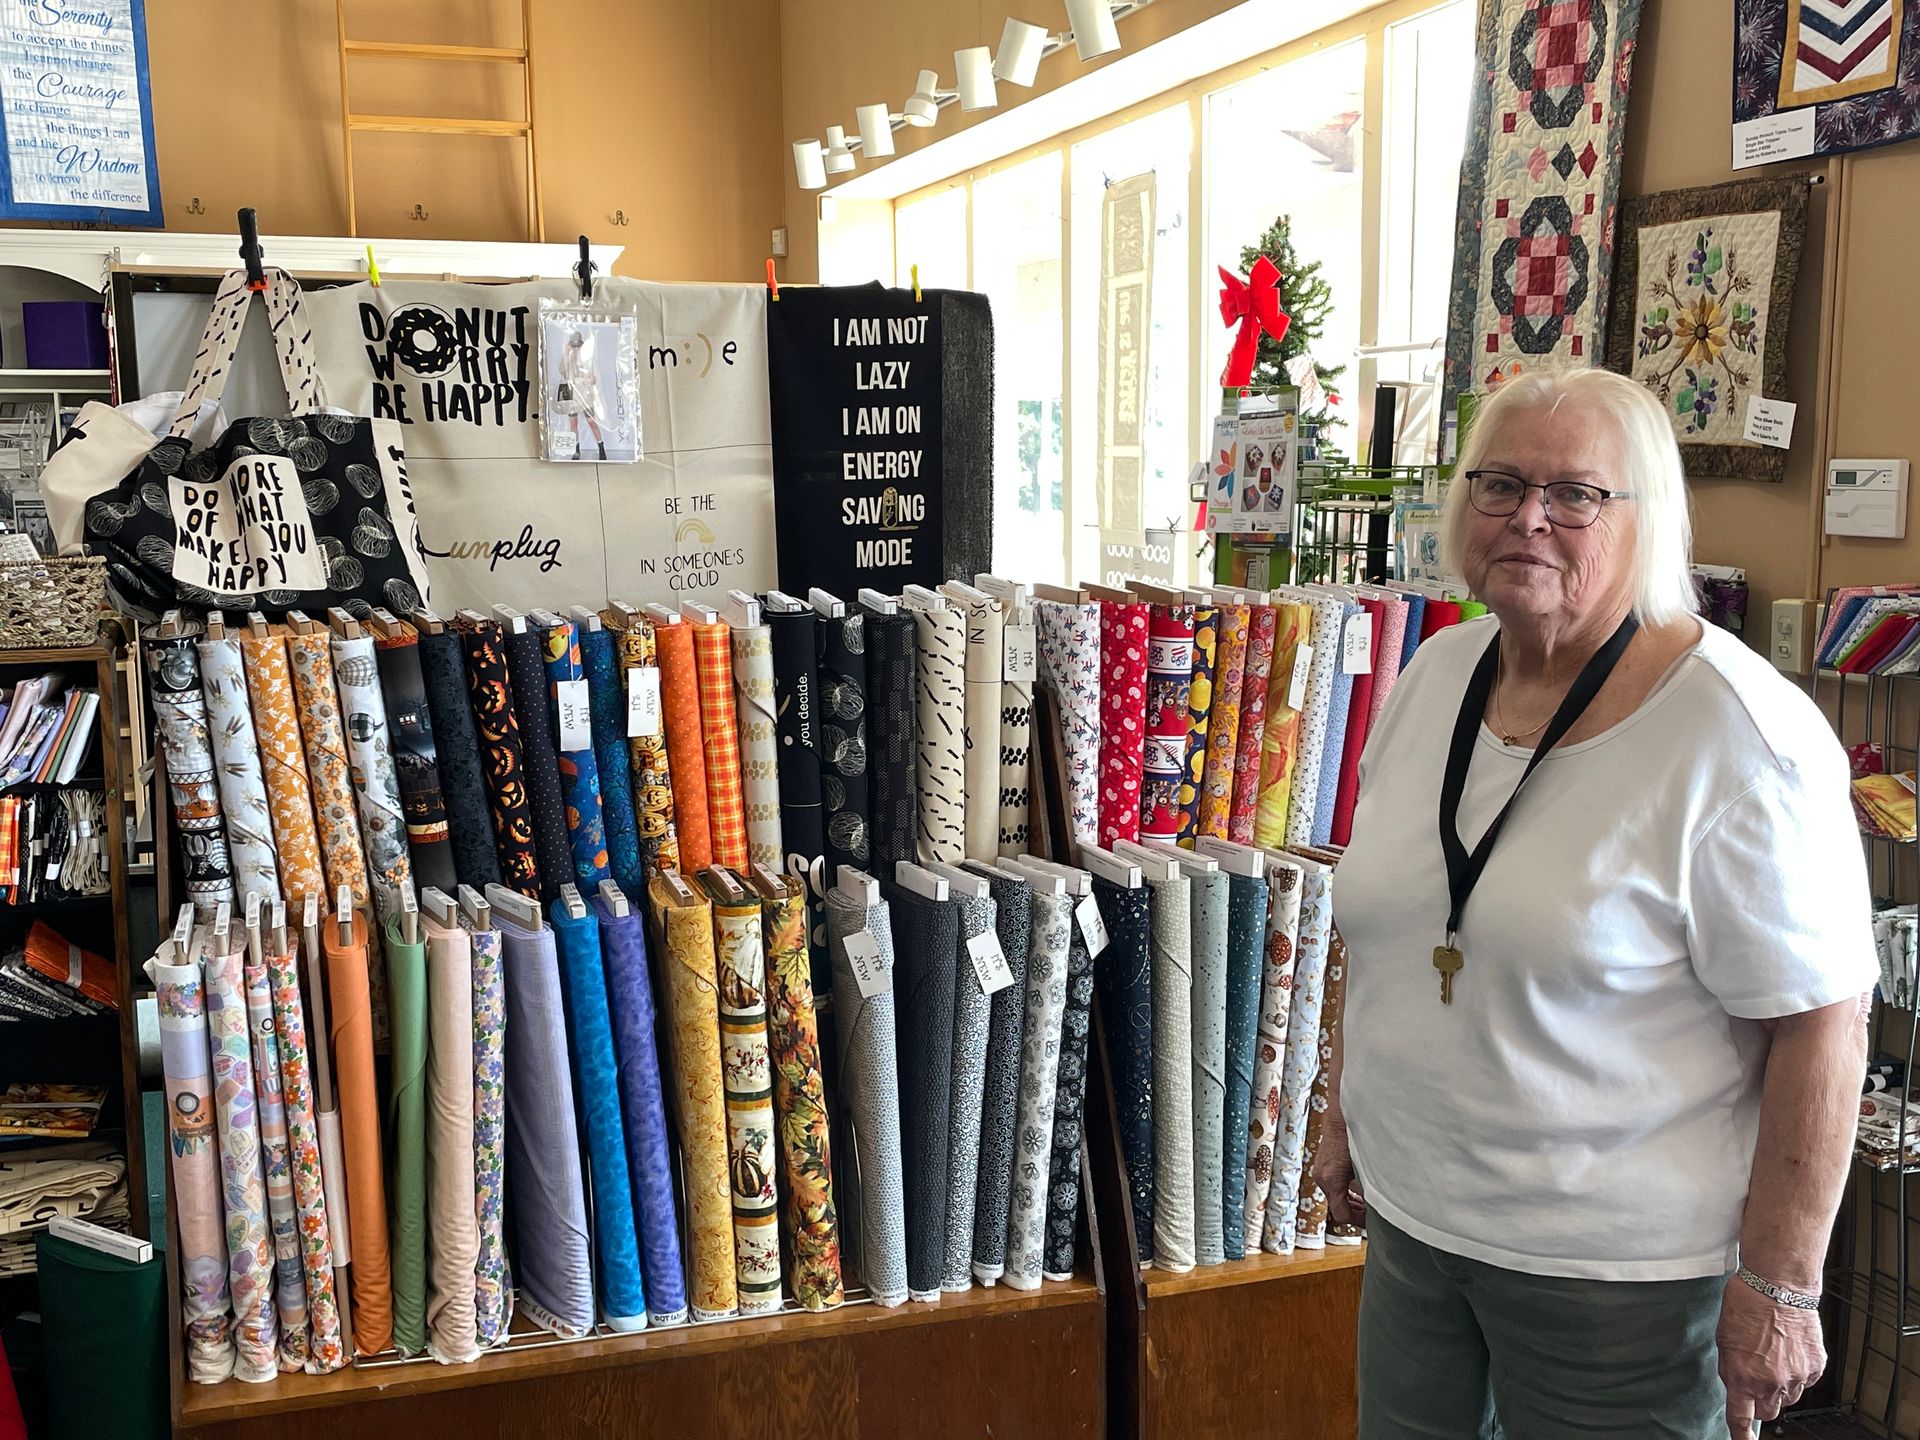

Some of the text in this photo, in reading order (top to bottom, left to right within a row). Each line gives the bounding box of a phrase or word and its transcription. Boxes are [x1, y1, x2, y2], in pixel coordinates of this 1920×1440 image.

[29, 0, 114, 36] Serenity
[12, 31, 125, 55] to accept the things
[24, 50, 29, 61] I
[33, 53, 72, 66] cannot
[13, 67, 128, 110] the Courage
[14, 101, 71, 119] to change
[15, 136, 60, 150] and the
[47, 122, 131, 139] the things I can
[56, 144, 141, 176] Wisdom
[35, 172, 82, 186] to know
[70, 189, 143, 203] the difference
[833, 315, 929, 347] I AM NOT
[855, 361, 911, 391] LAZY
[842, 405, 921, 436] I AM ON
[843, 450, 923, 481] ENERGY
[184, 462, 284, 510] DO MORE
[187, 492, 284, 537] OF WHAT
[664, 493, 716, 514] BE THE
[842, 491, 925, 526] SAVING
[179, 522, 307, 566] MAKES YOU
[450, 524, 562, 572] unplug
[856, 538, 913, 568] MODE
[208, 554, 287, 591] HAPPY
[640, 548, 744, 574] IN SOMEONE'S
[669, 570, 719, 591] CLOUD
[970, 628, 986, 645] IN
[1008, 646, 1018, 673] NEW
[563, 702, 575, 730] NEW
[646, 688, 656, 716] NEW
[796, 672, 814, 748] you decide.
[854, 955, 871, 982] NEW
[974, 956, 992, 982] NEW
